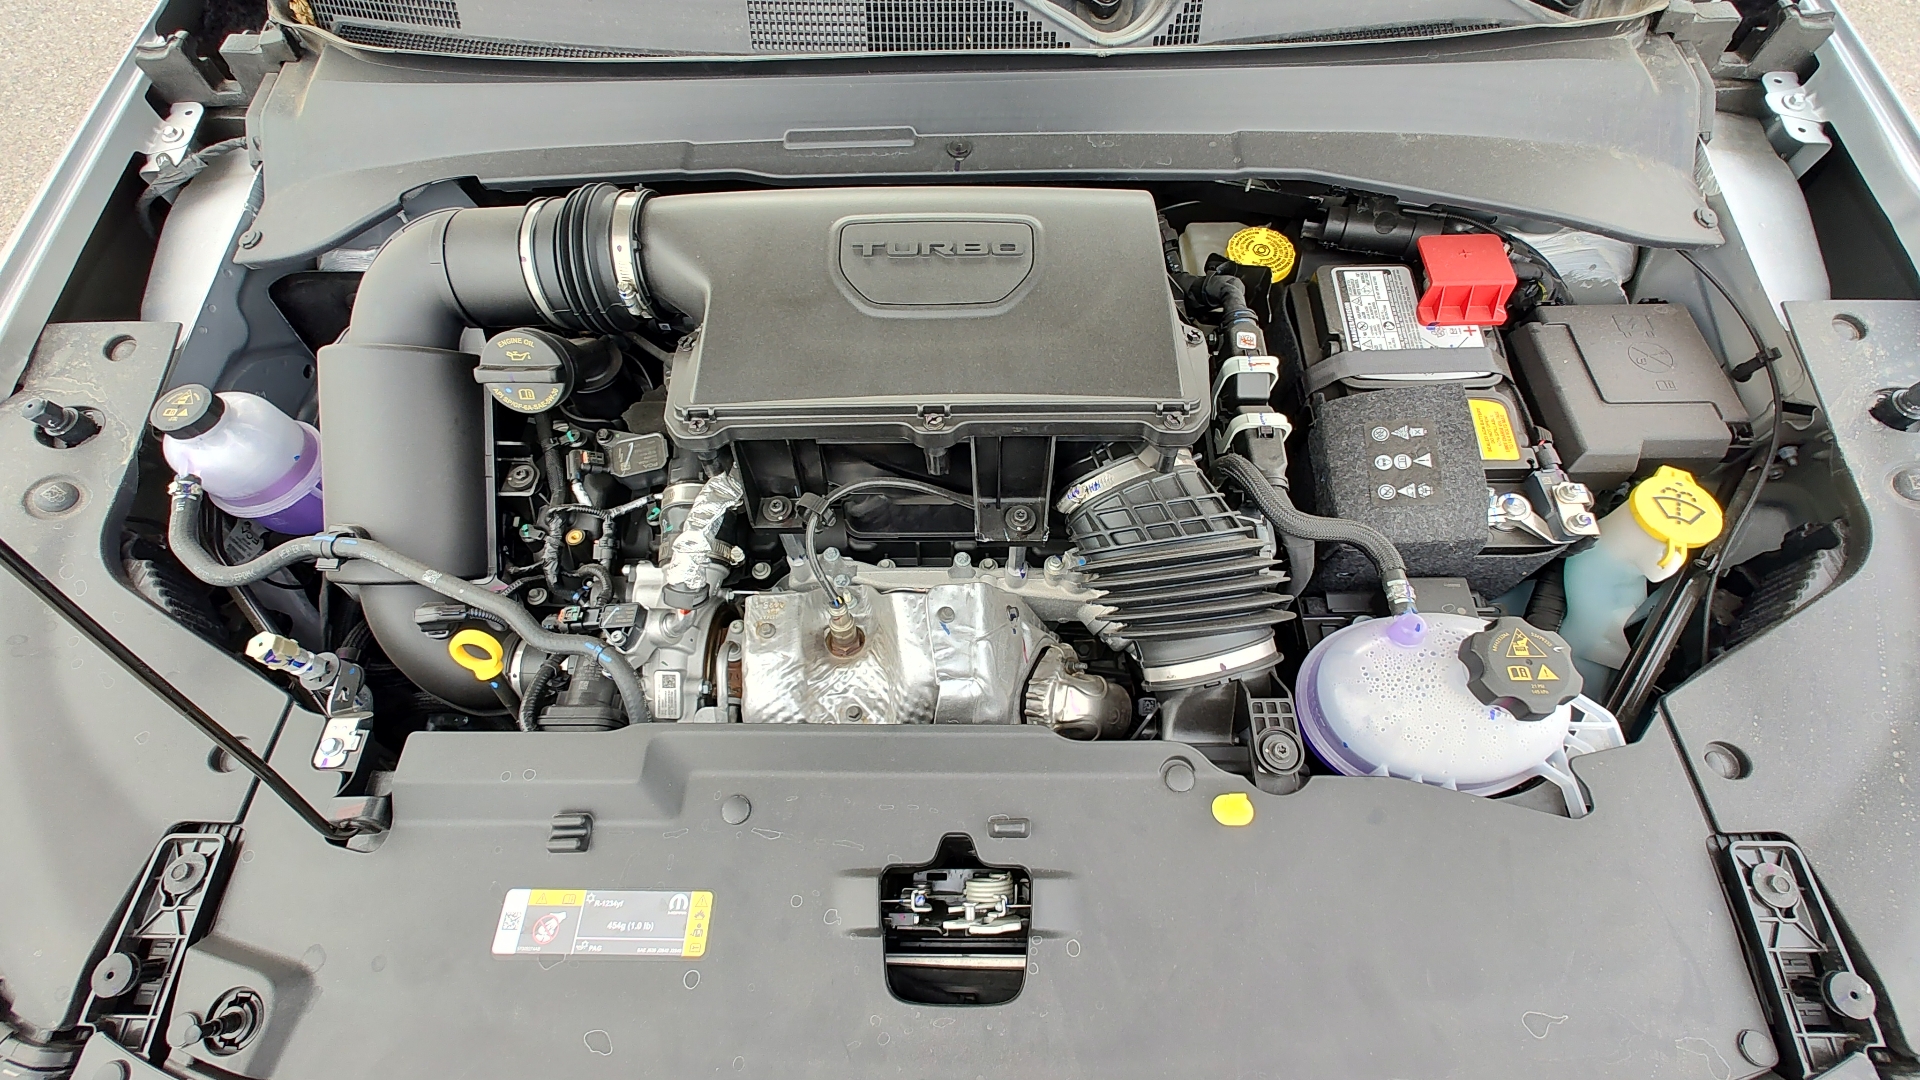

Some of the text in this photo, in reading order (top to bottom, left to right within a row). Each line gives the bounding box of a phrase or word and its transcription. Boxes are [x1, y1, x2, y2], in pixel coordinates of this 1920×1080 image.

[852, 241, 1024, 258] TURBO
[497, 338, 535, 348] ENGINE OIL
[492, 388, 504, 399] API
[594, 899, 624, 909] R-1234yf
[607, 921, 654, 932] 454g (1.0 lb)
